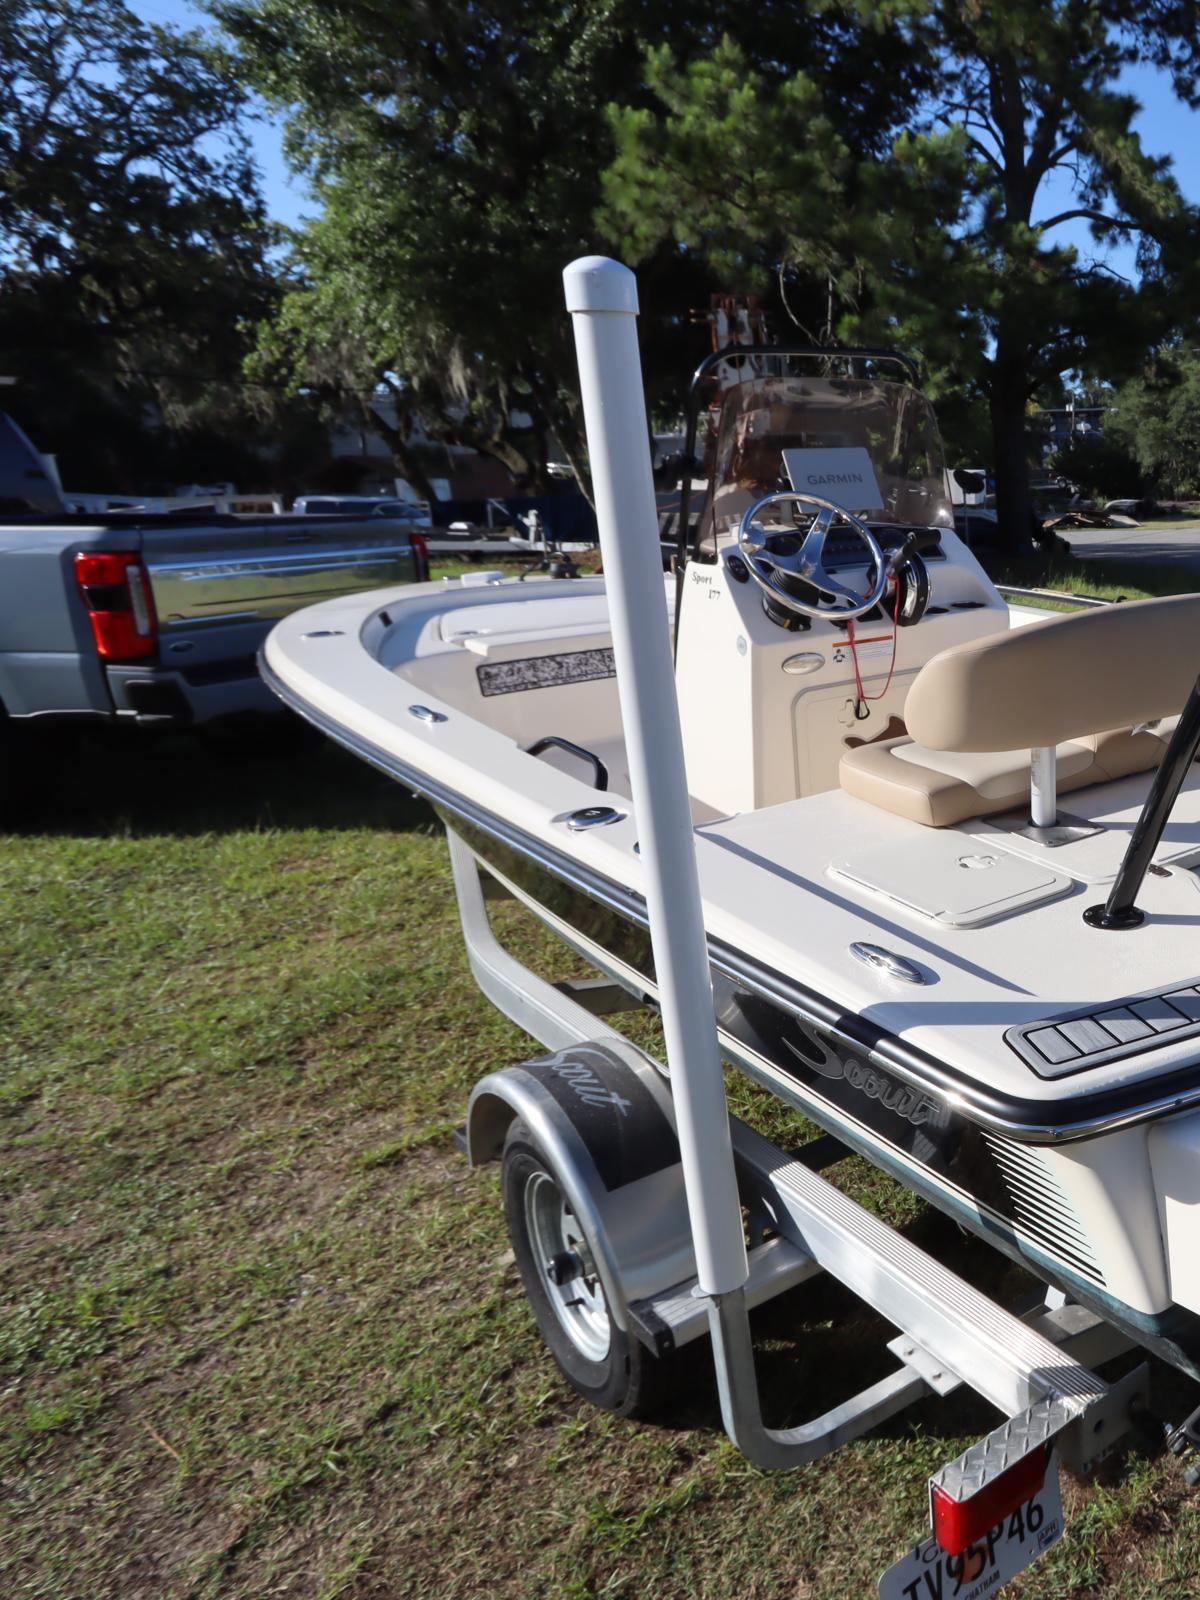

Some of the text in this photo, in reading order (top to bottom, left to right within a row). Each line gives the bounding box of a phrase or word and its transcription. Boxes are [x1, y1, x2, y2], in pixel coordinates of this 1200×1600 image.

[807, 473, 863, 485] GARMIN
[692, 571, 712, 585] Sport
[709, 589, 721, 601] 177
[521, 1047, 633, 1117] Scout
[964, 1569, 1001, 1600] CHATHAM
